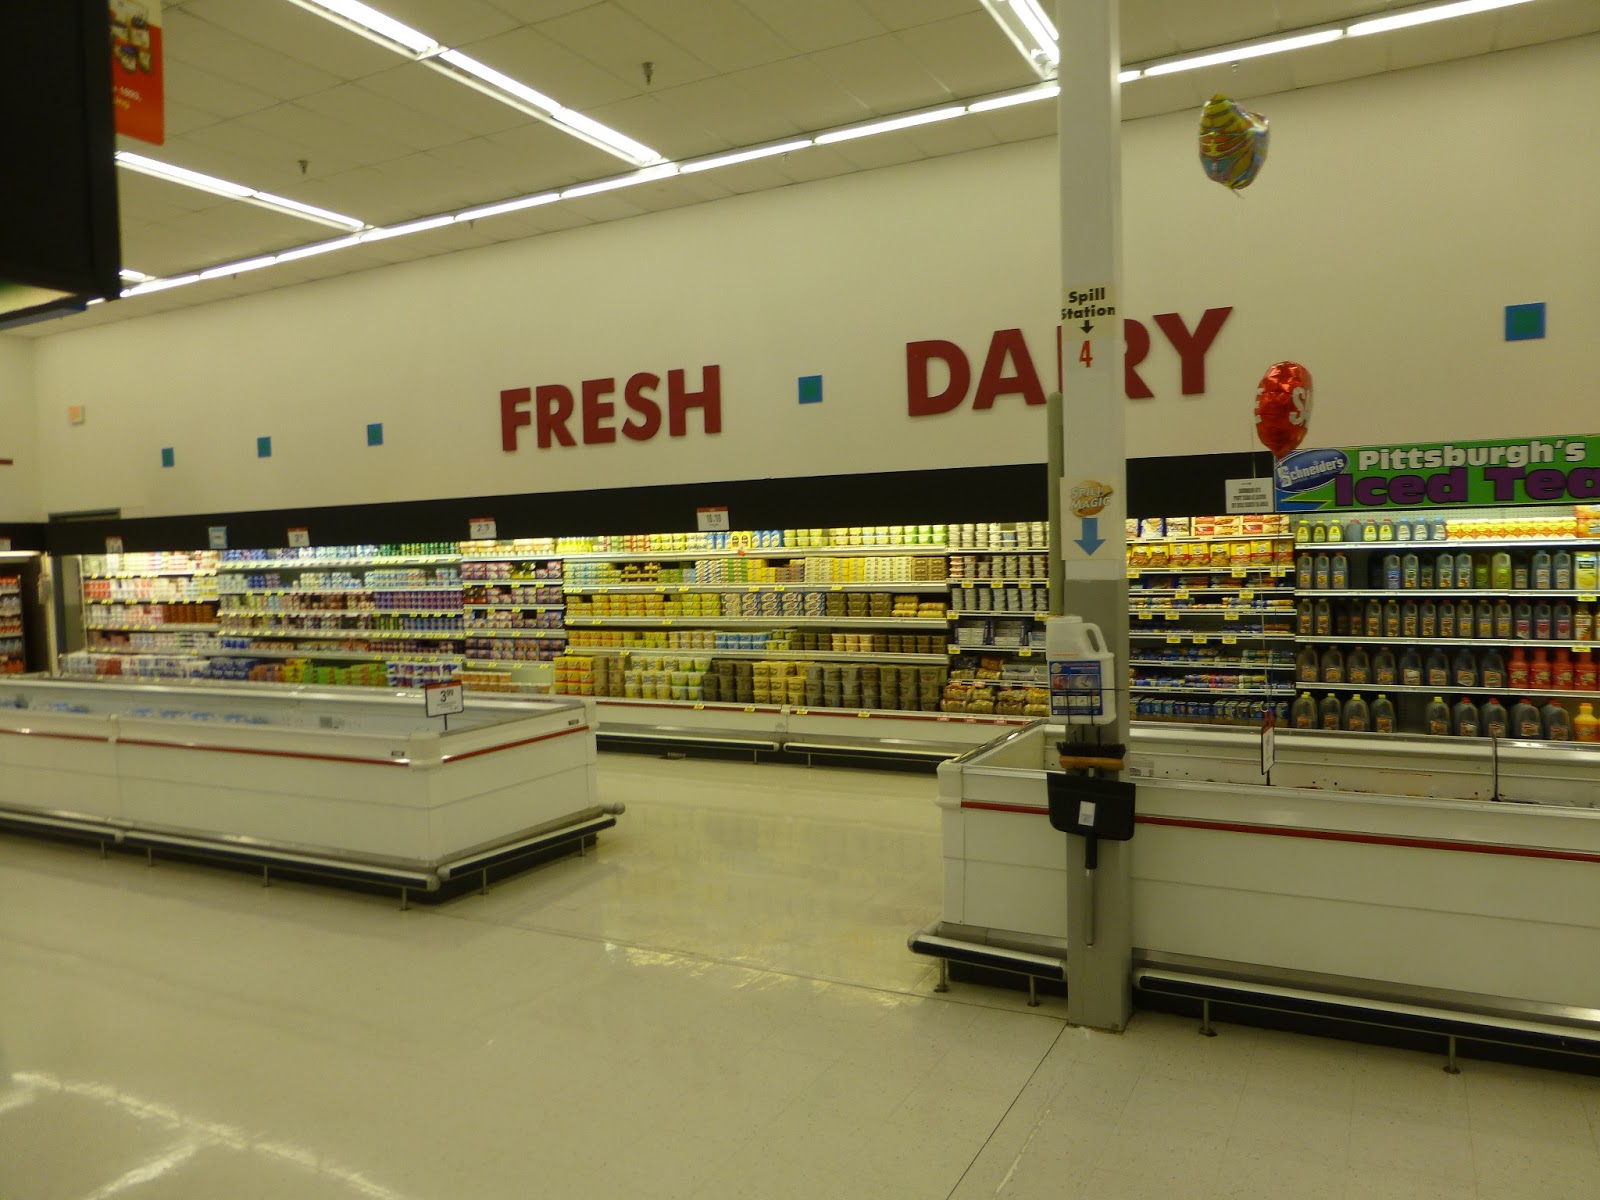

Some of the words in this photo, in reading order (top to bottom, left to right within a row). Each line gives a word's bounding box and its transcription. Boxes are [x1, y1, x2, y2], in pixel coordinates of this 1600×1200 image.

[1069, 287, 1105, 306] Spill
[1079, 340, 1093, 368] 4
[500, 364, 721, 452] FRESH
[907, 307, 1233, 417] DARY
[1358, 439, 1587, 471] Pittsburgh's
[1277, 456, 1345, 488] Schneider's
[1335, 467, 1468, 506] Iced
[1484, 467, 1600, 501] Tea
[1071, 496, 1111, 510] MAGIC
